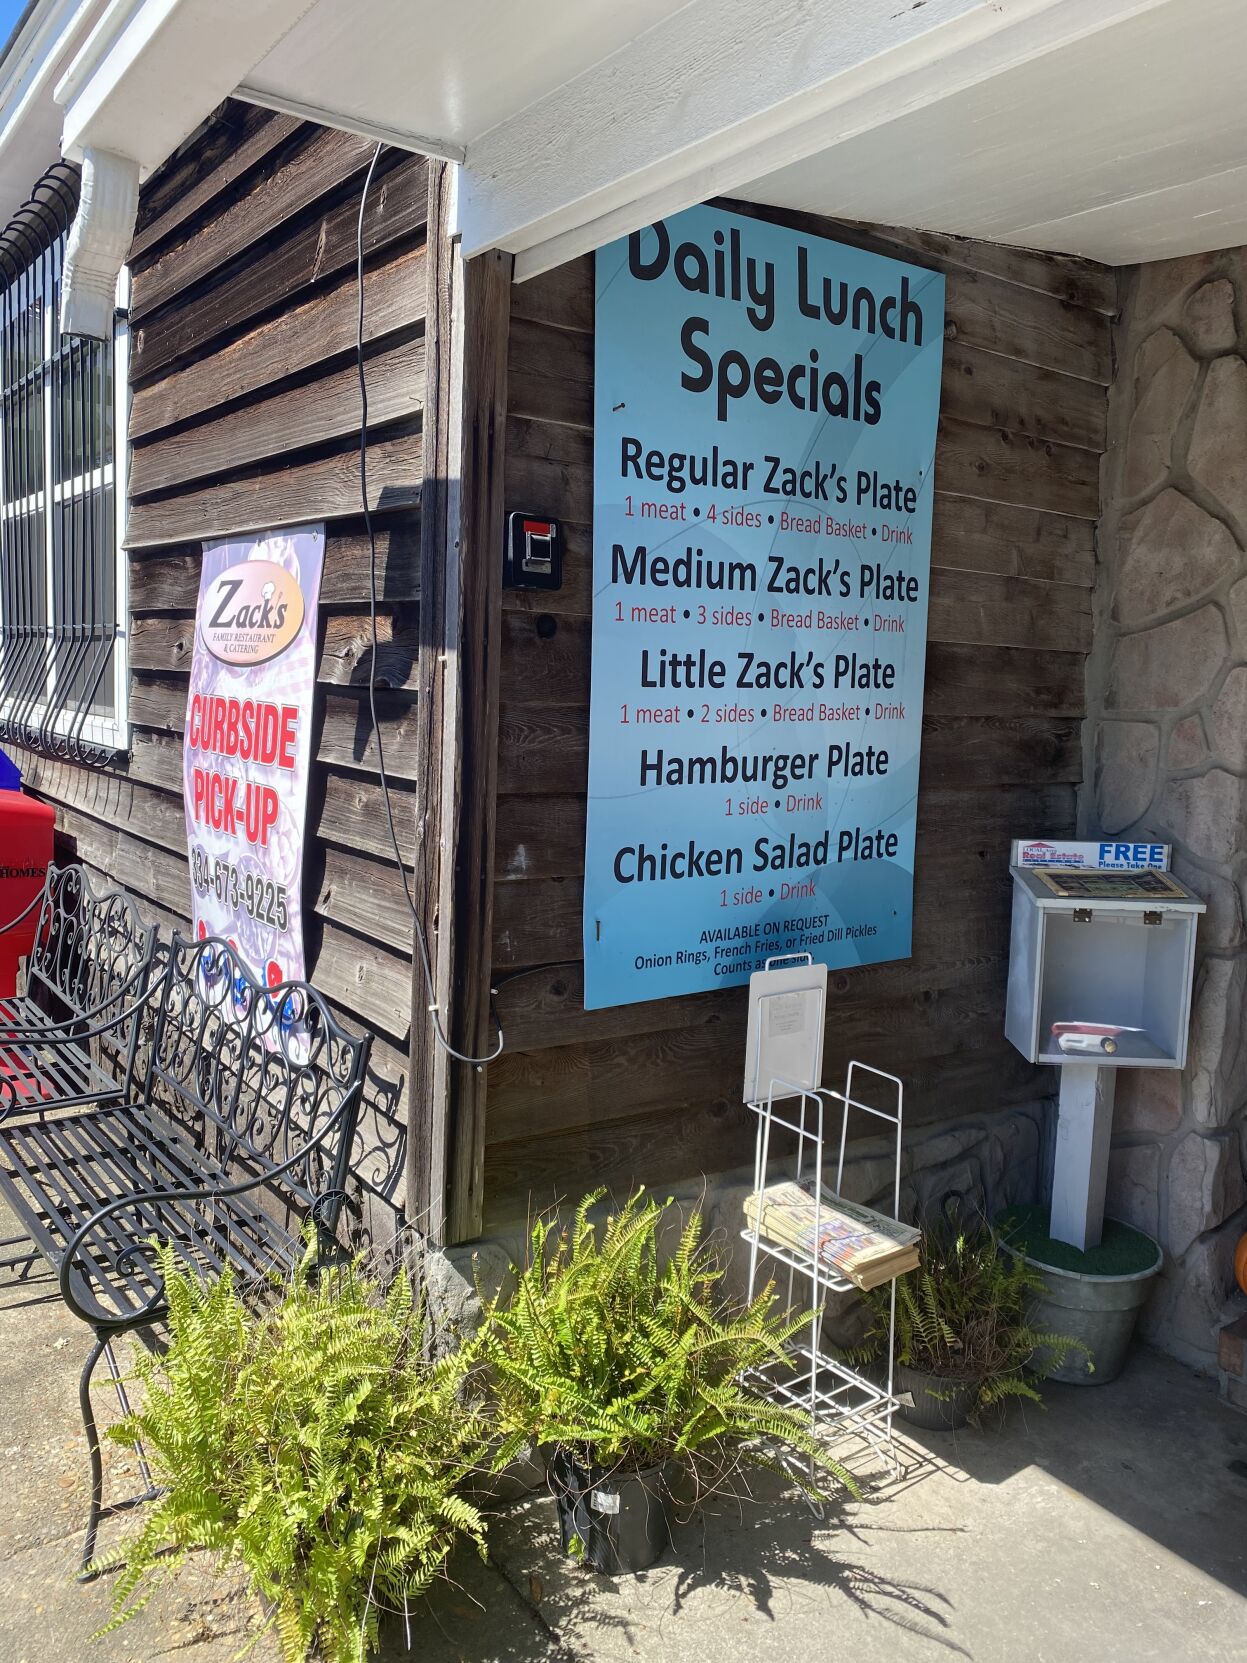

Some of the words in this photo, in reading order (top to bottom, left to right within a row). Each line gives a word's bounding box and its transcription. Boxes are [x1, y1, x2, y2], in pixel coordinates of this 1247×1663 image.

[628, 219, 775, 331] Daily
[797, 245, 923, 346] Lunch
[681, 316, 882, 425] Specials
[621, 437, 754, 493] Regular
[763, 455, 847, 503] Zack's
[856, 470, 917, 513] Plate
[625, 495, 635, 516] 1
[641, 500, 686, 521] meat
[707, 504, 717, 523] 4
[722, 505, 762, 528] sides
[780, 511, 821, 535] Bread
[825, 516, 867, 539] Basket
[881, 524, 913, 545] Drink
[611, 544, 757, 591] Medium
[767, 555, 851, 598] Zack's
[860, 563, 919, 602] Plate
[208, 579, 288, 630] Zack's
[615, 601, 625, 621] 1
[631, 603, 676, 624] meat
[697, 605, 707, 625] 3
[712, 606, 752, 627] sides
[771, 608, 812, 630] Bread
[817, 610, 859, 631] Basket
[874, 614, 905, 633] Drink
[213, 632, 235, 642] FAMILY
[234, 633, 276, 643] RESTAURANT
[223, 643, 229, 653] &
[229, 643, 259, 654] CATERING
[641, 649, 726, 688] Little
[736, 650, 825, 689] Zack's
[834, 652, 895, 689] Plate
[189, 693, 299, 770] CURBSIDE
[620, 704, 630, 723] 1
[636, 705, 680, 724] meat
[700, 704, 711, 723] 2
[715, 703, 755, 723] sides
[773, 703, 815, 722] Bread
[819, 702, 861, 721] Basket
[874, 702, 906, 720] Drink
[640, 746, 819, 789] Hamburger
[827, 742, 889, 779] Plate
[193, 767, 279, 848] PICK-UP
[725, 798, 733, 816] 1
[738, 796, 769, 815] side
[785, 792, 823, 812] Drink
[613, 840, 743, 884] Chicken
[752, 830, 829, 872] Salad
[837, 826, 898, 863] Plate
[1098, 843, 1164, 863] FREE
[1098, 860, 1124, 869] Please
[1127, 861, 1145, 870] Take
[192, 847, 288, 932] 334-673-9225
[719, 889, 728, 907] 1
[732, 885, 763, 905] side
[779, 878, 817, 901] Drink
[634, 953, 672, 970] Onion
[676, 949, 711, 965] Rings,
[714, 940, 751, 960] French
[754, 939, 783, 955] Fries,
[785, 936, 796, 949] or
[800, 929, 824, 947] Fried
[827, 927, 843, 942] Dill
[846, 924, 877, 939] Pickles
[699, 923, 761, 944] AVAILABLE
[763, 921, 779, 935] ON
[783, 914, 829, 934] REQUEST
[713, 959, 752, 976] Counts
[755, 958, 766, 970] as
